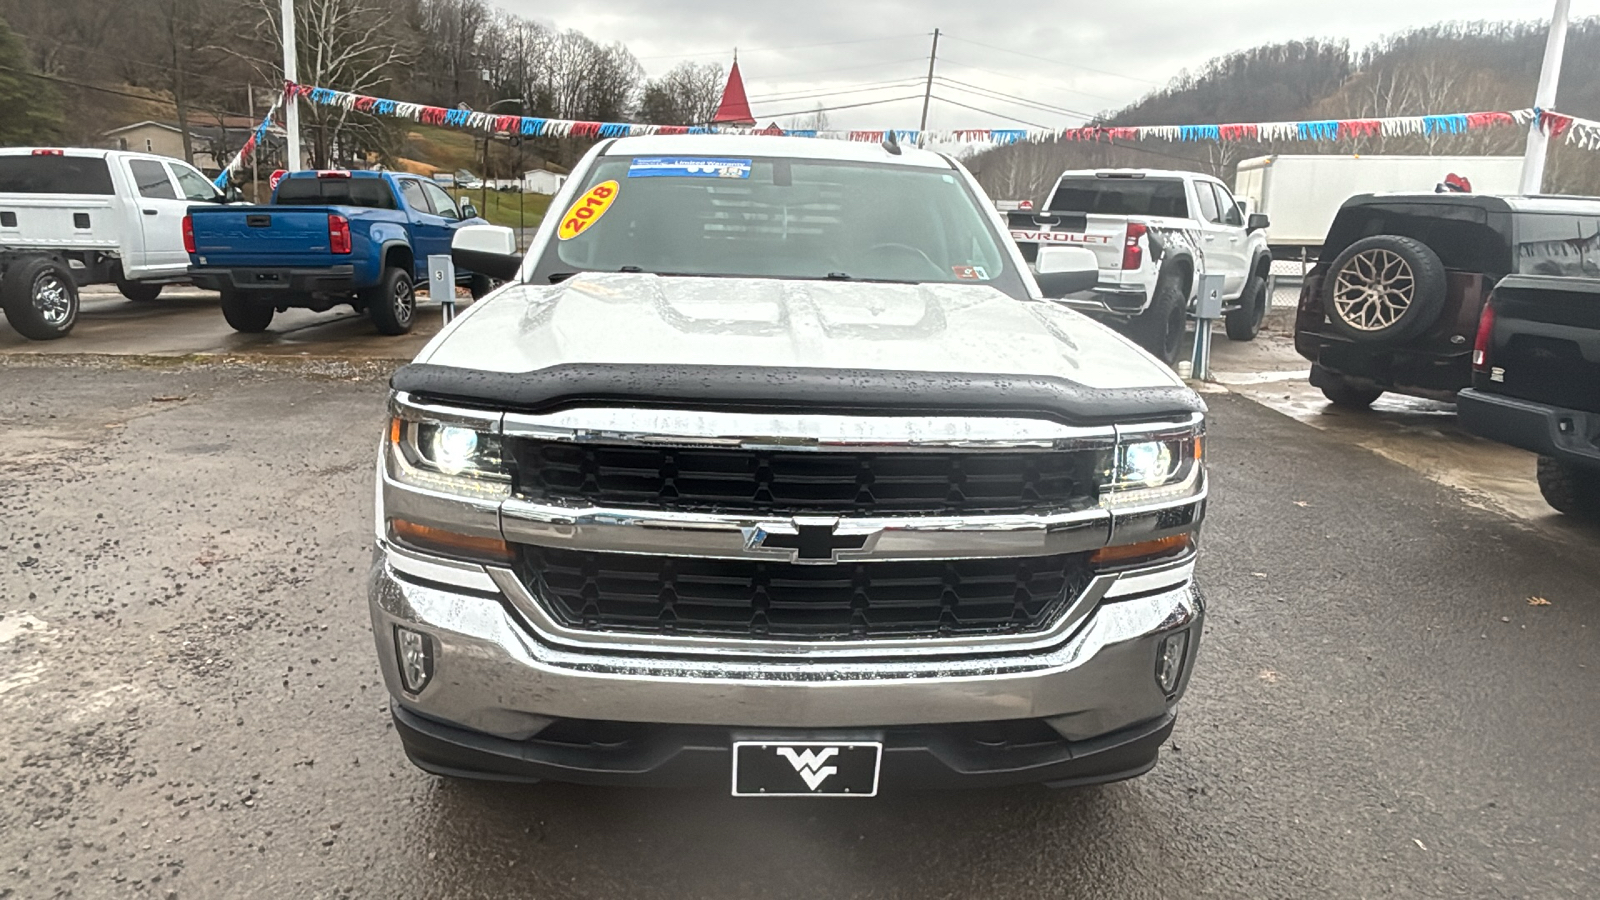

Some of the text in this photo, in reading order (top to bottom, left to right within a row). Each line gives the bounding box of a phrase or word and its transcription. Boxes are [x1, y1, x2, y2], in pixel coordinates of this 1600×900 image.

[565, 186, 613, 233] 2018
[1010, 231, 1113, 244] EVROLET
[436, 271, 443, 280] 3
[1211, 289, 1217, 298] 4
